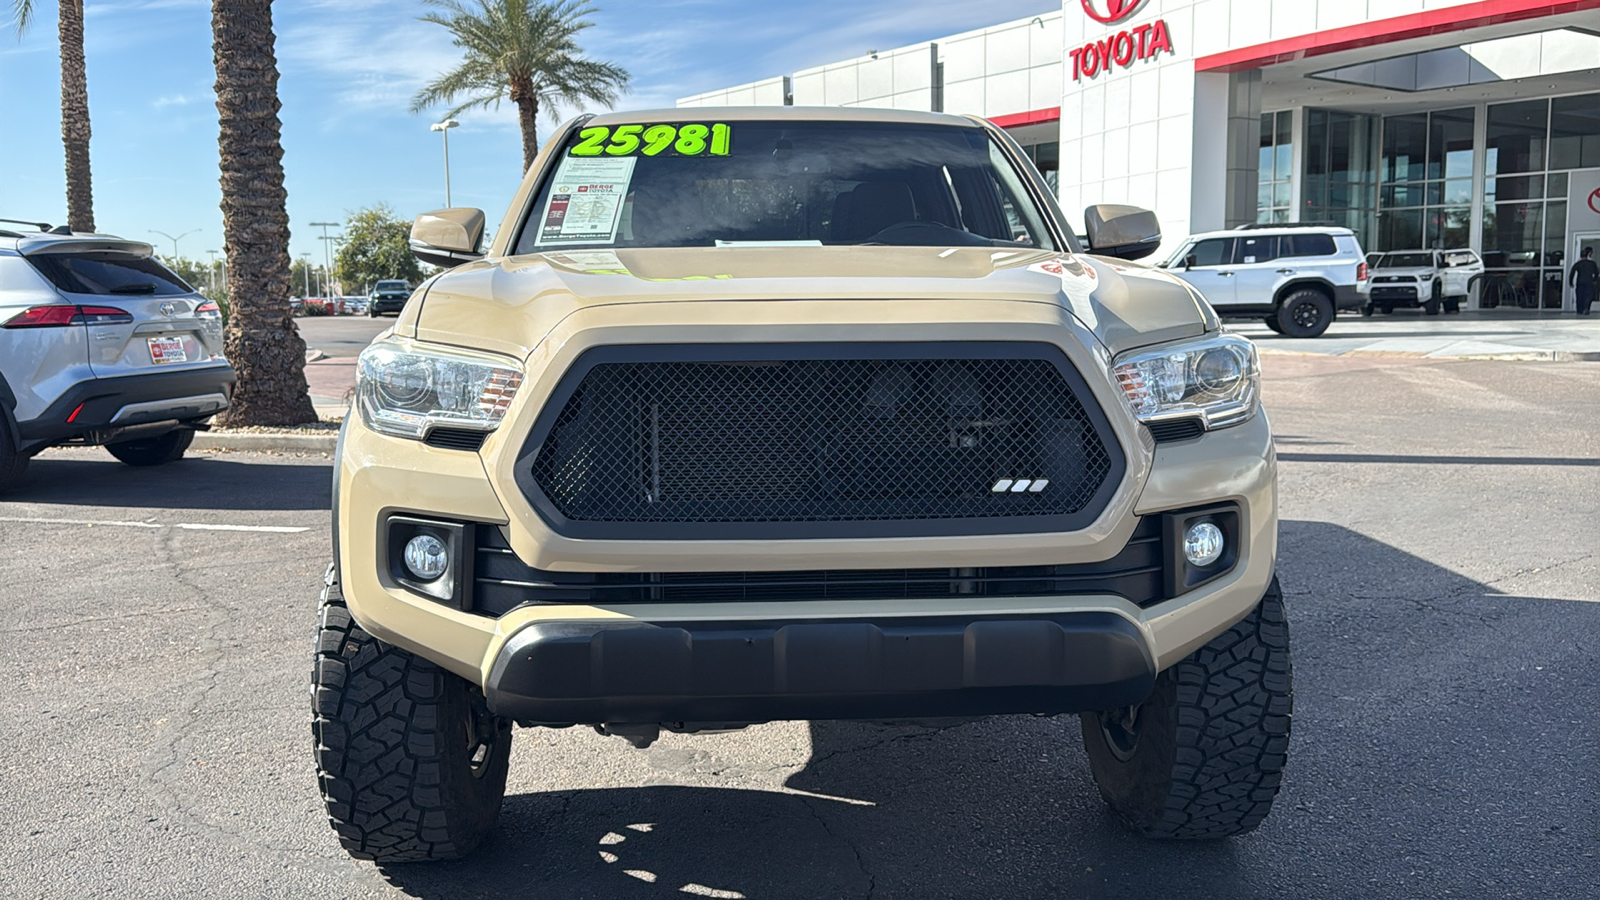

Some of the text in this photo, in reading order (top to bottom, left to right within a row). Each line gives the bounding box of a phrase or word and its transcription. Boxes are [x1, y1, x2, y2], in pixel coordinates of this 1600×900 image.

[1069, 19, 1172, 82] TOYOTA
[570, 123, 730, 156] 25981
[160, 342, 181, 351] BERGE
